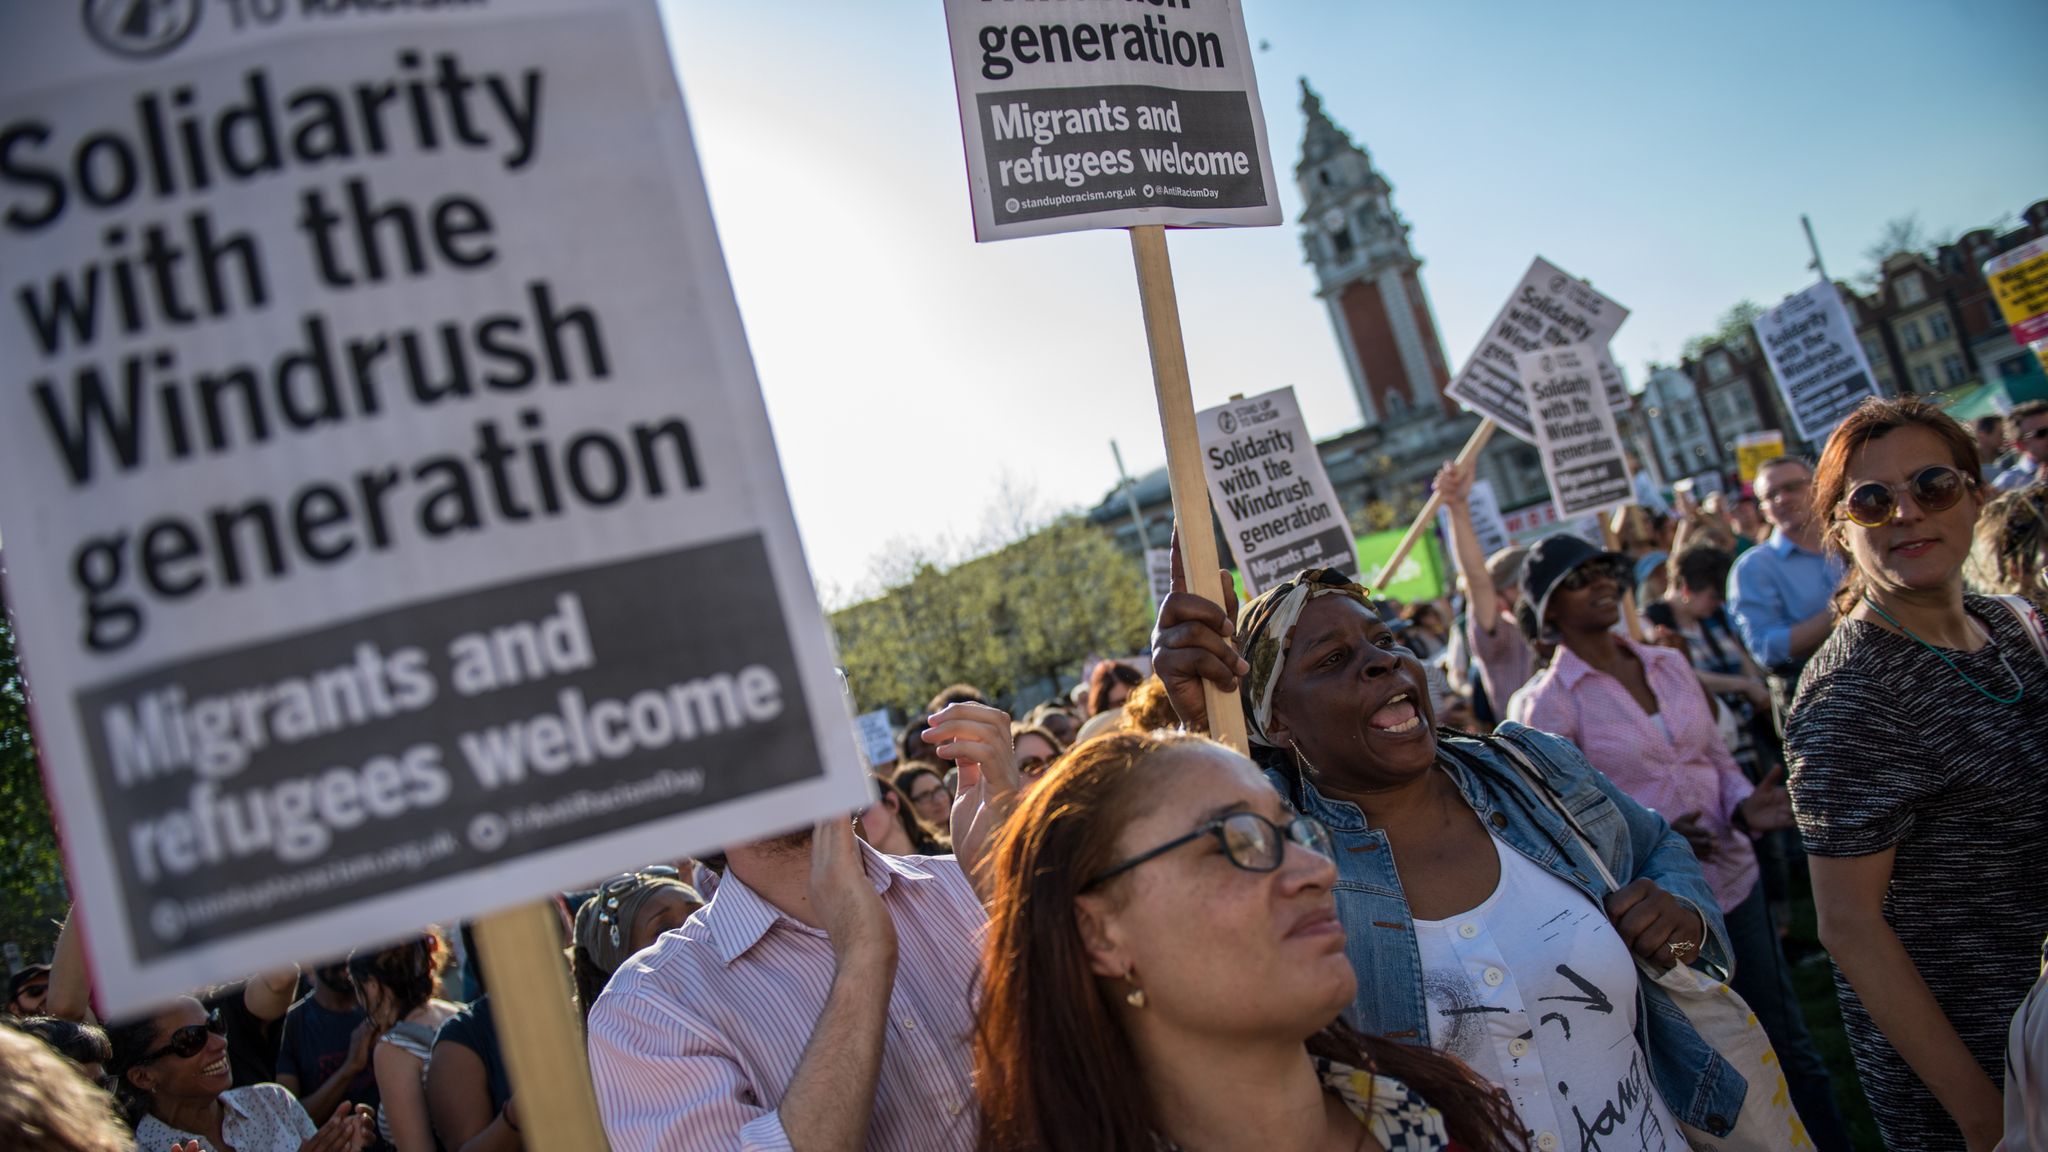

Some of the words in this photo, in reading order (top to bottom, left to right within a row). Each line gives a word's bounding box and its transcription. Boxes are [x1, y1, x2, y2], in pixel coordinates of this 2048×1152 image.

[979, 15, 1224, 80] generation
[0, 50, 545, 232] Solidarity
[990, 100, 1129, 145] Migrants
[1136, 101, 1181, 133] and
[999, 147, 1134, 187] refugees
[1140, 142, 1250, 176] welcome
[1021, 187, 1137, 210] standuptoracism.org.uk
[1155, 185, 1219, 199] @AntiRacismDay
[17, 211, 269, 357] with
[299, 176, 498, 291] the
[32, 281, 612, 487] Windrush
[1208, 429, 1294, 470] Solidarity
[1219, 470, 1261, 496] with
[1263, 457, 1293, 481] the
[1226, 476, 1314, 522] Windrush
[1239, 501, 1331, 553] generation
[70, 409, 705, 655] generation
[102, 638, 437, 788] Migrants
[450, 591, 596, 695] and
[130, 745, 450, 885] refugees
[461, 665, 784, 790] welcome
